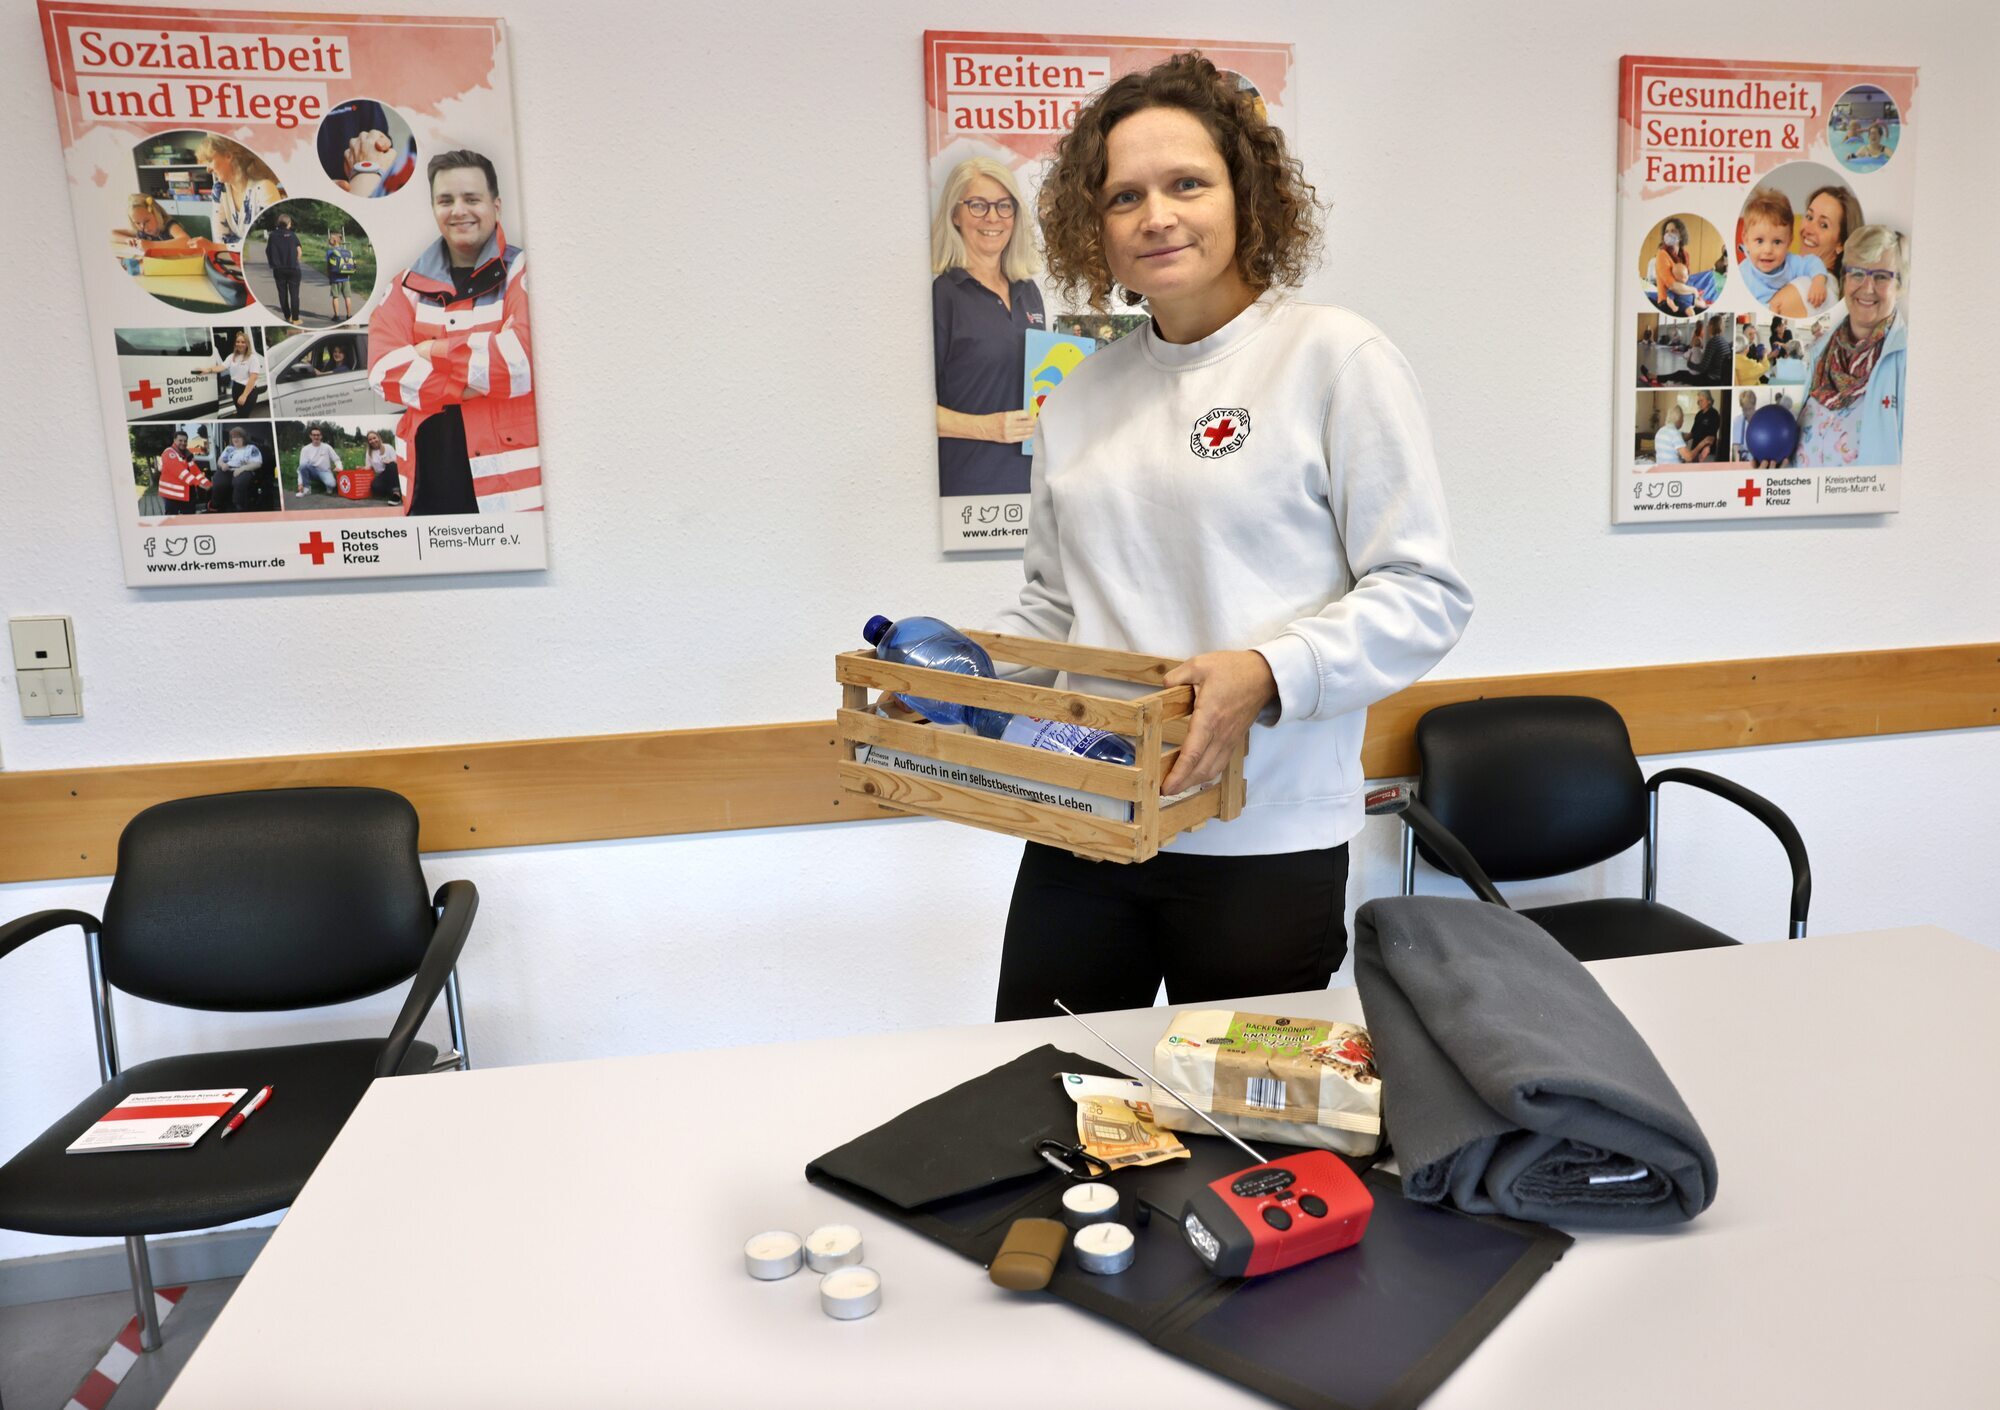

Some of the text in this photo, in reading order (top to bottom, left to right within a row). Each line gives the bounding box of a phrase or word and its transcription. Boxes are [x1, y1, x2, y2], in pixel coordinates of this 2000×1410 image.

[79, 31, 344, 73] Sozialarbeit
[952, 56, 1105, 89] Breiten-
[87, 82, 321, 129] und Pflege
[1646, 80, 1818, 119] Gesundheit,
[954, 96, 1081, 130] ausbild
[1646, 119, 1800, 149] Senioren &
[1645, 155, 1751, 184] Familie
[166, 375, 209, 386] Deutsches
[167, 386, 193, 395] Rotes
[168, 394, 193, 405] Kreuz
[1199, 410, 1248, 427] DEUTSCHES
[1193, 433, 1210, 456] ROTES
[1212, 433, 1246, 456] KREUZ
[1766, 477, 1812, 487] Deutsches
[1825, 474, 1876, 484] Kreisverband
[1766, 487, 1791, 496] Rotes
[1824, 483, 1886, 494] Rems-Murr e.V.
[1633, 500, 1727, 511] www.drk-rems-murr.de
[1765, 497, 1791, 506] Kreuz
[341, 528, 408, 541] Deutsches
[428, 523, 505, 537] Kreisverband
[962, 527, 1029, 538] www.drk-rem
[342, 541, 379, 552] Rotes
[429, 534, 521, 548] Rems-Murr e.V.
[147, 557, 286, 572] www.drk-rems-murr.de
[343, 553, 380, 564] Kreuz
[893, 757, 1093, 813] Aufbruch in ein selbstbestimmtes Leben
